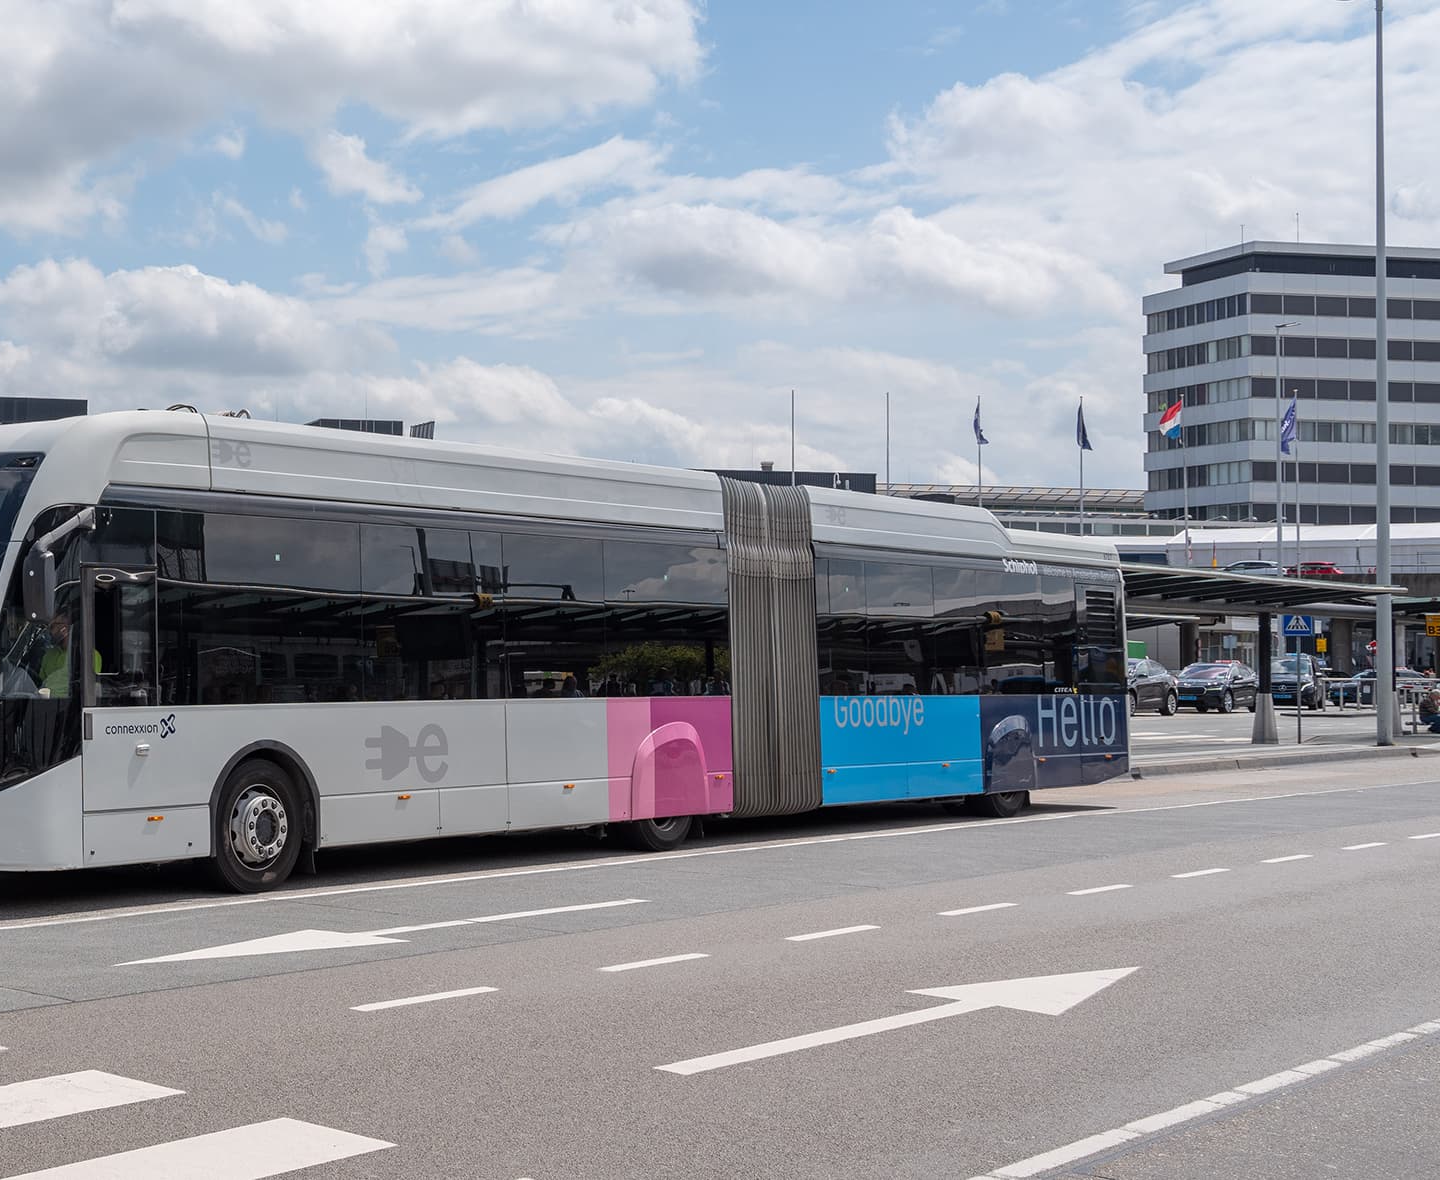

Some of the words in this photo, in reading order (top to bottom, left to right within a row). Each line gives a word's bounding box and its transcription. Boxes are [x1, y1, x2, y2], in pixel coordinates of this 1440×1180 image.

[1002, 559, 1038, 575] Schiphol
[834, 696, 924, 735] Goodbye
[1038, 695, 1116, 747] Hello
[105, 724, 158, 735] connexxion
